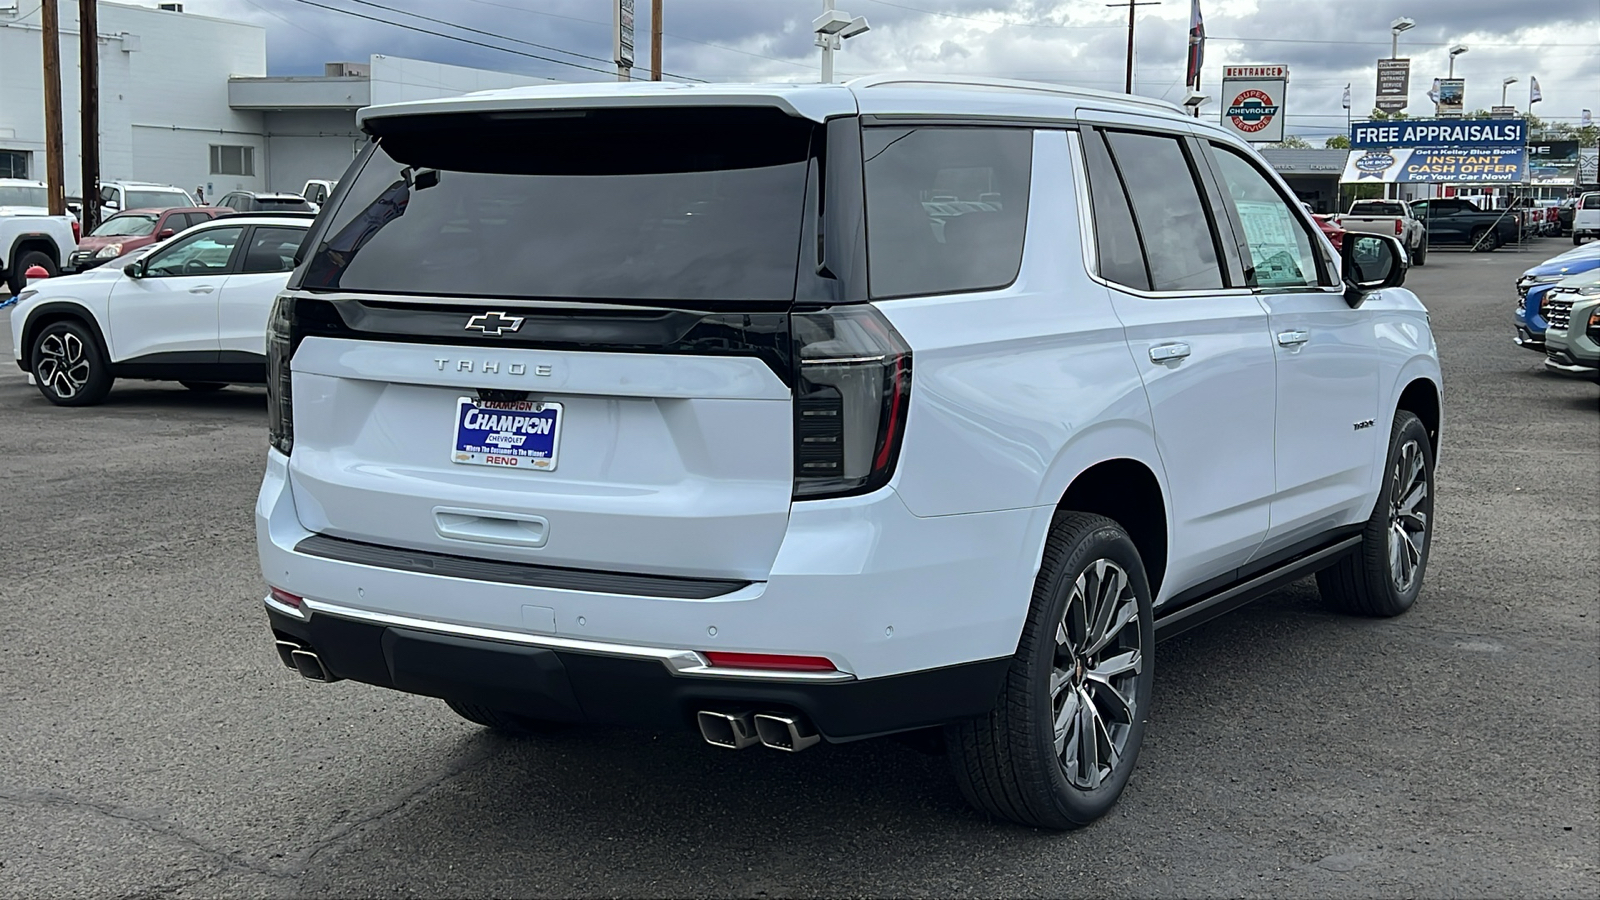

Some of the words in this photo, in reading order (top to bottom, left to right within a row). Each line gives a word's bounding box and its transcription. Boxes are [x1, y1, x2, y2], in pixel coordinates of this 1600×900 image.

[1232, 67, 1276, 76] ENTRANCE
[1237, 90, 1268, 102] SUPER
[1233, 116, 1270, 132] SERVICE
[1356, 127, 1400, 143] FREE
[1402, 125, 1521, 142] APPRAISALS!
[1426, 156, 1502, 164] INSTANT
[1407, 165, 1456, 173] CASH
[1461, 164, 1518, 173] OFFER
[434, 358, 553, 376] TAHOE
[484, 400, 533, 411] CHAMPION
[463, 408, 553, 435] CHAMPION
[488, 435, 524, 444] CHEVROLET
[490, 447, 513, 455] Customer
[486, 456, 519, 466] RENO
